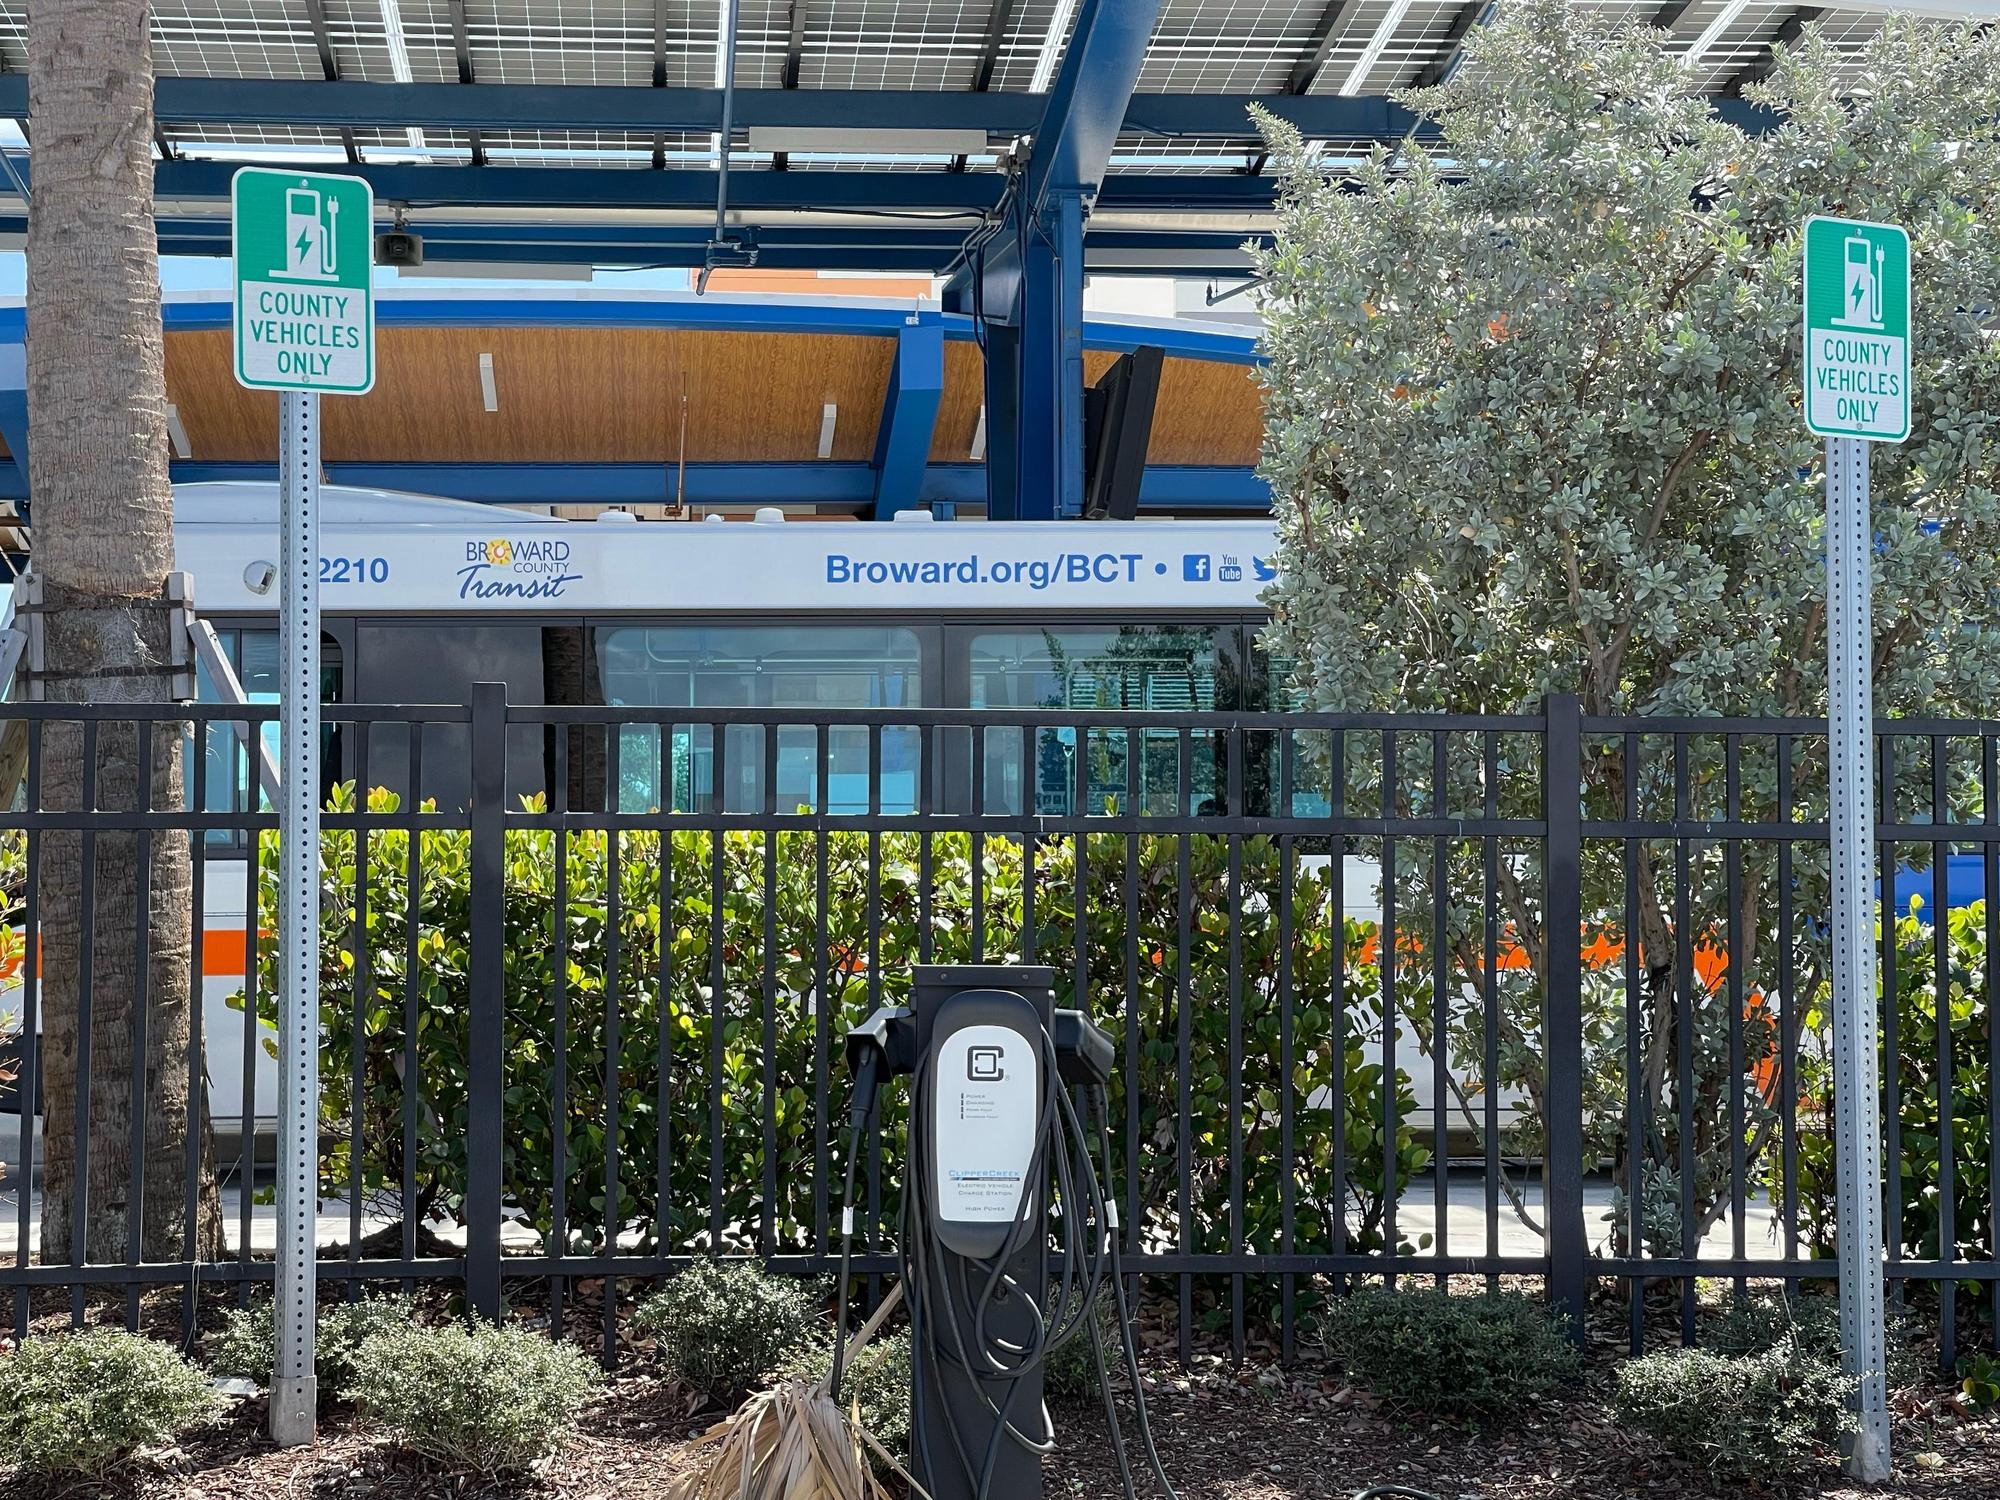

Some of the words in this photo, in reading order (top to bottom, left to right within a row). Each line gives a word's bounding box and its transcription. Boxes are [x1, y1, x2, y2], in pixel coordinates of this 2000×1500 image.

[260, 291, 348, 319] COUNTY
[250, 320, 359, 349] VEHICLES
[278, 350, 332, 376] ONLY
[1824, 338, 1892, 367] COUNTY
[1817, 367, 1899, 397] VEHICLES
[1837, 397, 1879, 423] ONLY
[466, 540, 570, 562] BROWARD
[1222, 554, 1238, 566] You
[319, 557, 389, 583] 2210
[513, 562, 570, 573] COUNTY
[827, 553, 1143, 590] Broward.org/BCT
[1219, 567, 1241, 580] Tube
[456, 563, 583, 599] Transit
